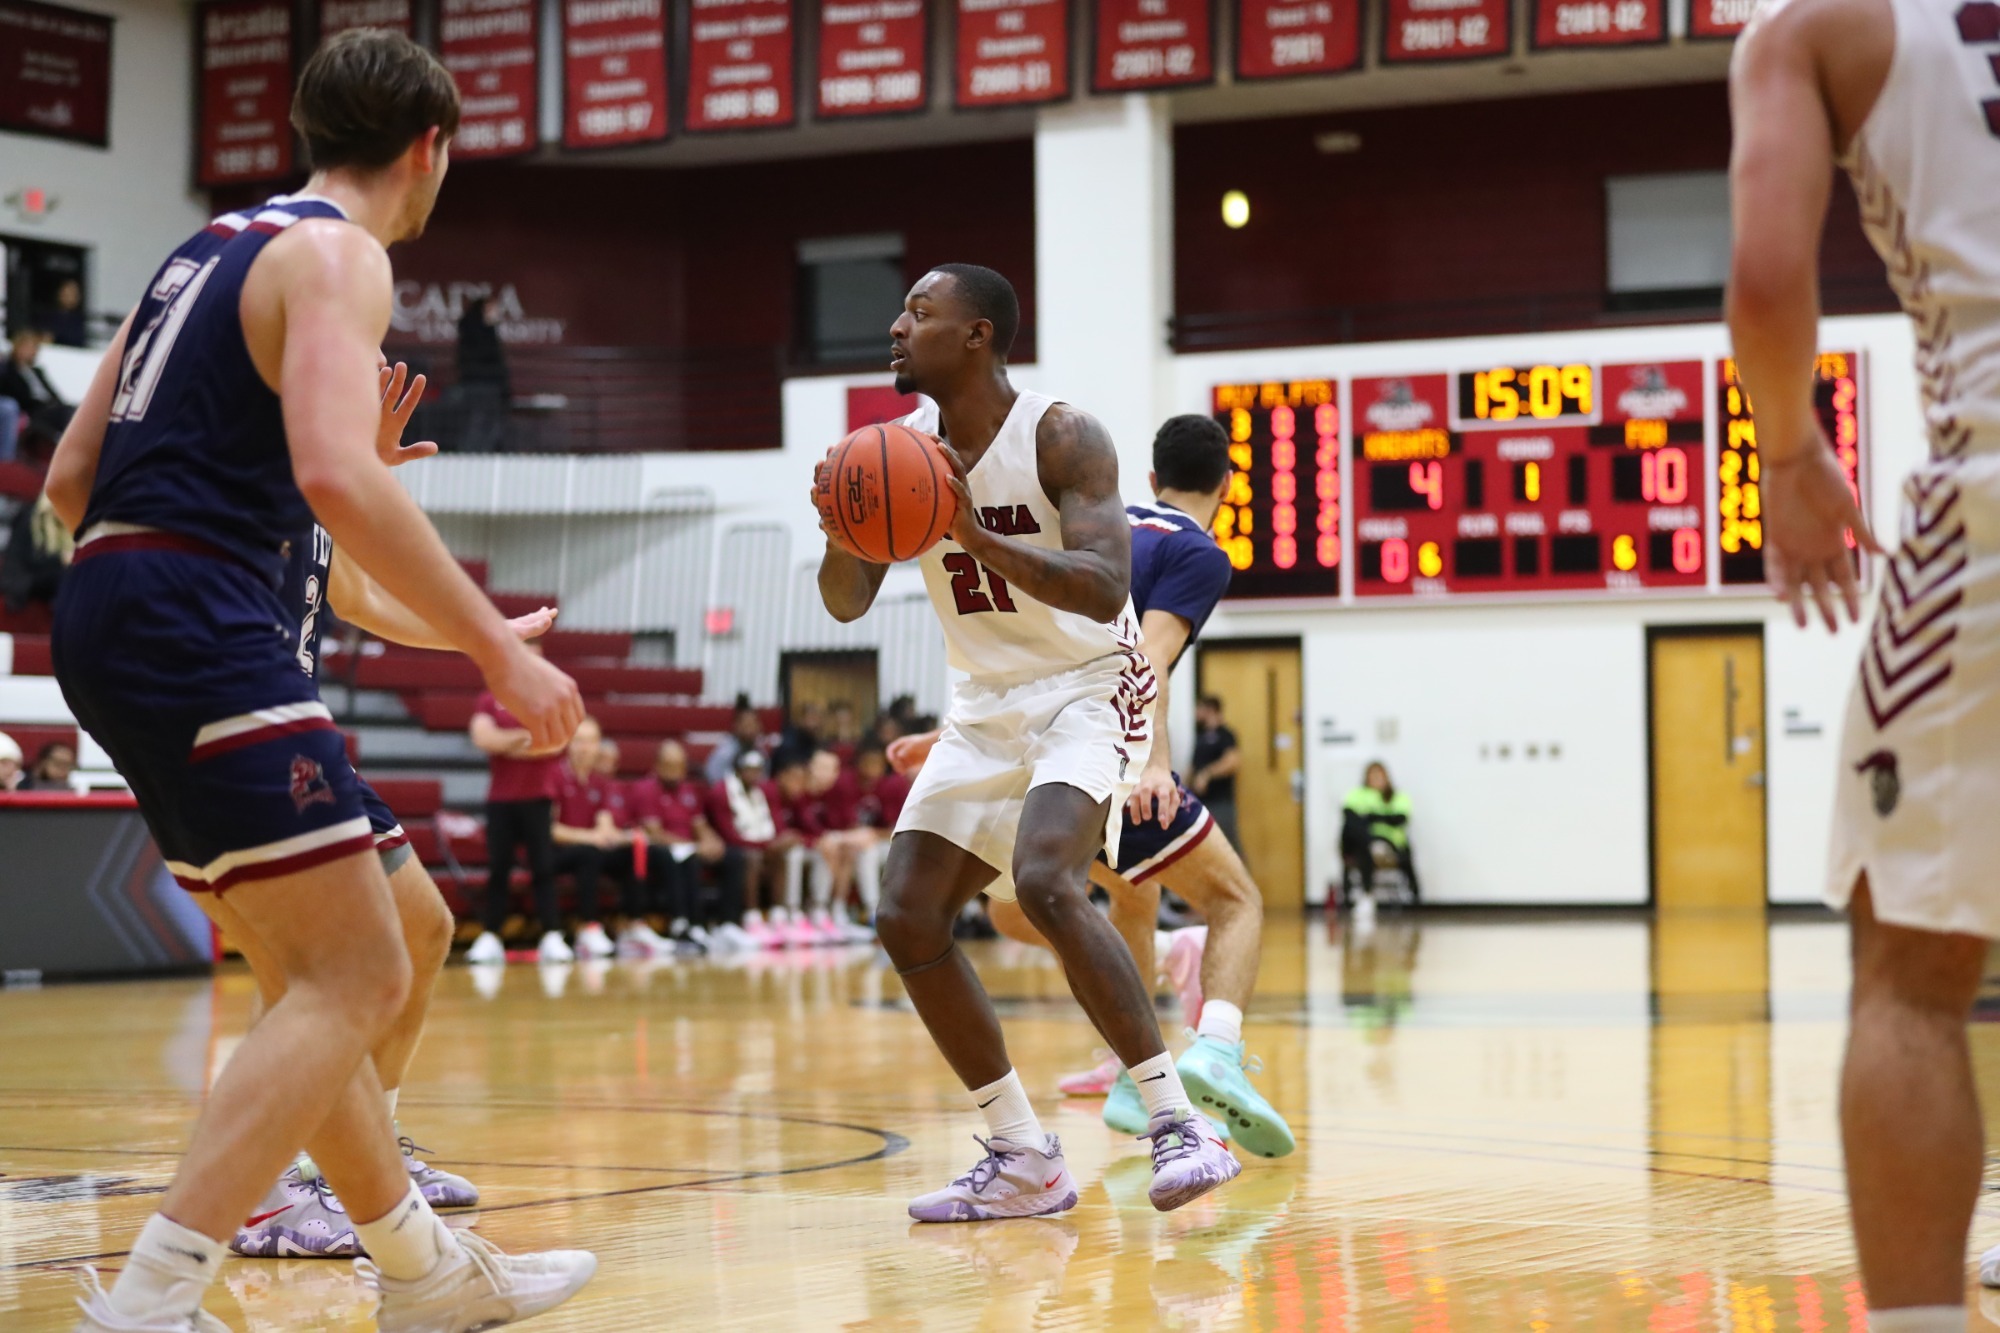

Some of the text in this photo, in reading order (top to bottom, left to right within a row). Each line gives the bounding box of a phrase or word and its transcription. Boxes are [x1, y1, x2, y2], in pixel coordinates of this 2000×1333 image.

[1401, 14, 1489, 50] 2001-02
[1557, 0, 1647, 35] 2001-02
[1271, 32, 1325, 66] 2001
[1474, 364, 1592, 421] 15:09
[1409, 461, 1442, 510] 4
[1525, 462, 1540, 501] 1
[1641, 448, 1687, 503] 10
[1381, 538, 1409, 583] 0
[1418, 542, 1442, 577] 6
[1613, 534, 1637, 571] 6
[1672, 527, 1701, 573] 0
[942, 552, 1018, 615] 21
[296, 574, 322, 678] 2
